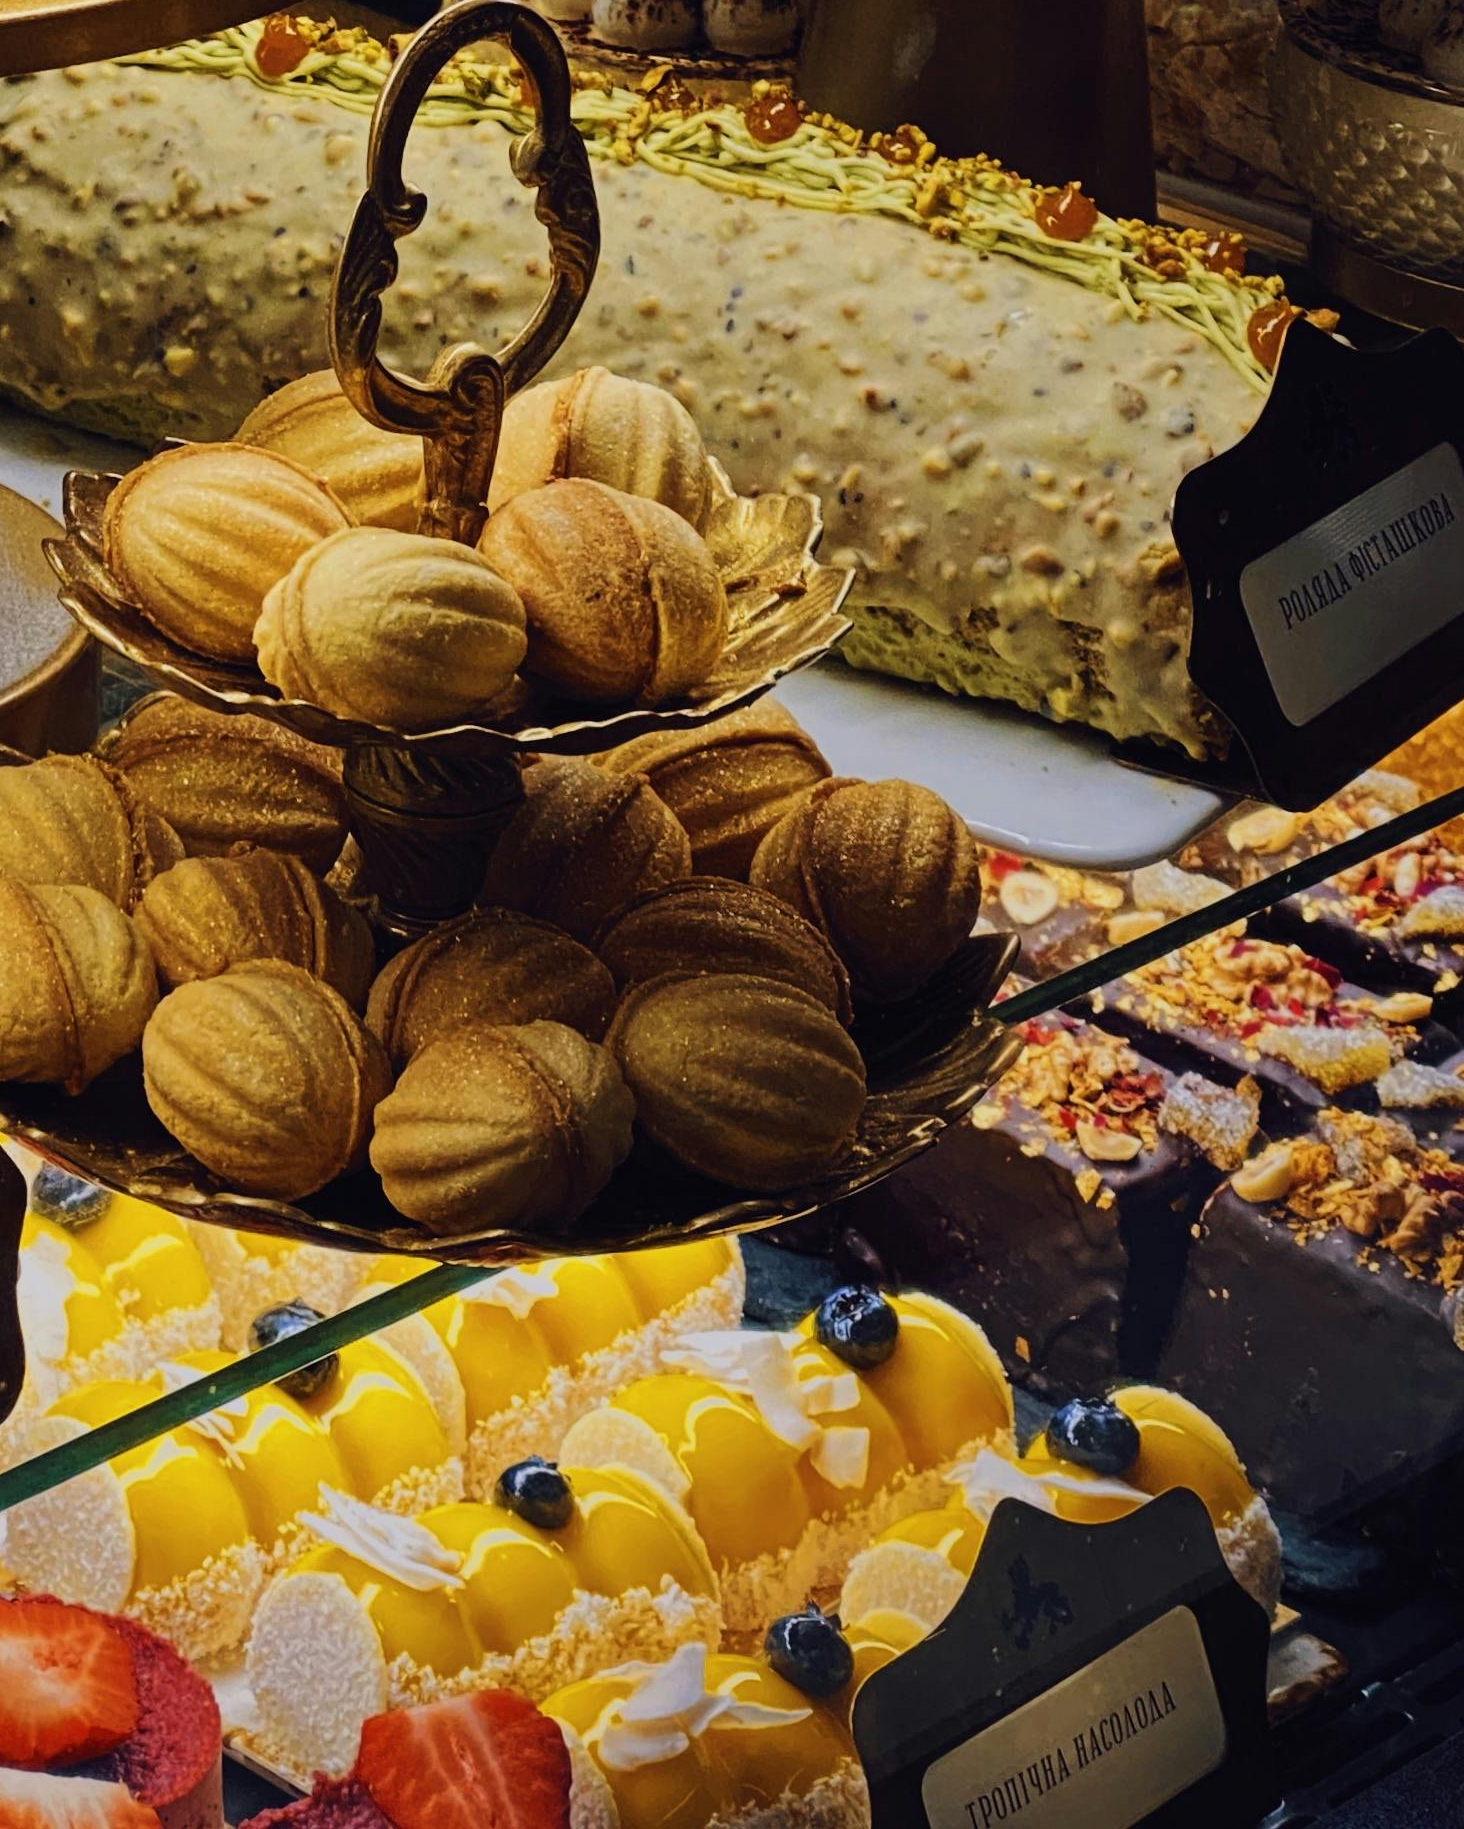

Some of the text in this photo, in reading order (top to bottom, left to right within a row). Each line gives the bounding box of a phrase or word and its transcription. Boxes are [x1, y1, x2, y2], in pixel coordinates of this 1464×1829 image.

[1278, 493, 1456, 631] РОЛЯДА ФІСТАШКОВА
[964, 1680, 1177, 1829] ТРОПІЧНА НАСОЛОДА
